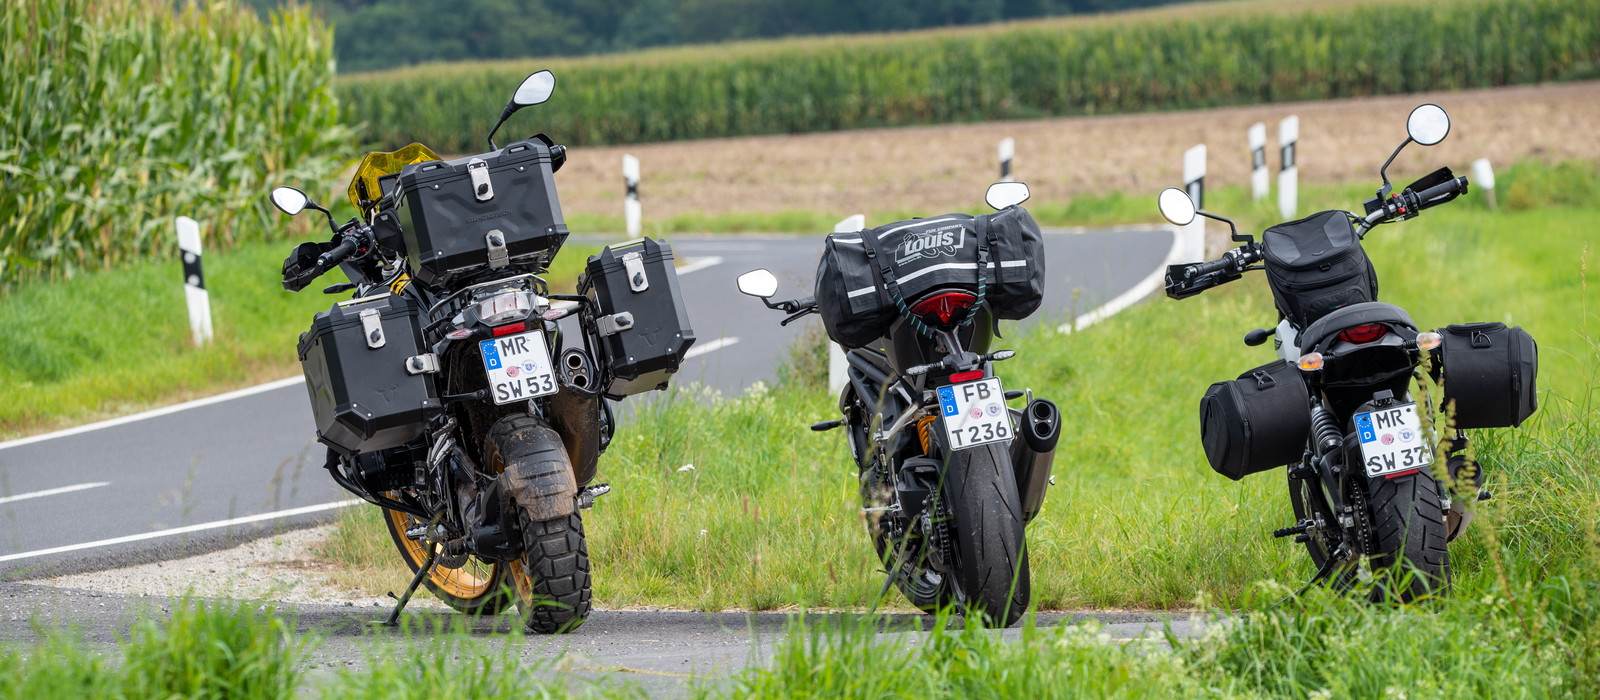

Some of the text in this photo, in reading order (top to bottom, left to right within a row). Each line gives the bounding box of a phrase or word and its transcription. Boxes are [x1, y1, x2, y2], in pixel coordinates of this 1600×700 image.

[904, 231, 954, 256] Louis
[500, 336, 529, 357] MR
[489, 358, 498, 367] D
[496, 373, 553, 401] SW 53
[962, 382, 991, 403] FB
[946, 404, 954, 413] D
[1375, 409, 1405, 430] MR
[951, 421, 1008, 446] T 236
[1363, 431, 1372, 440] D
[1369, 446, 1425, 473] SW 37
